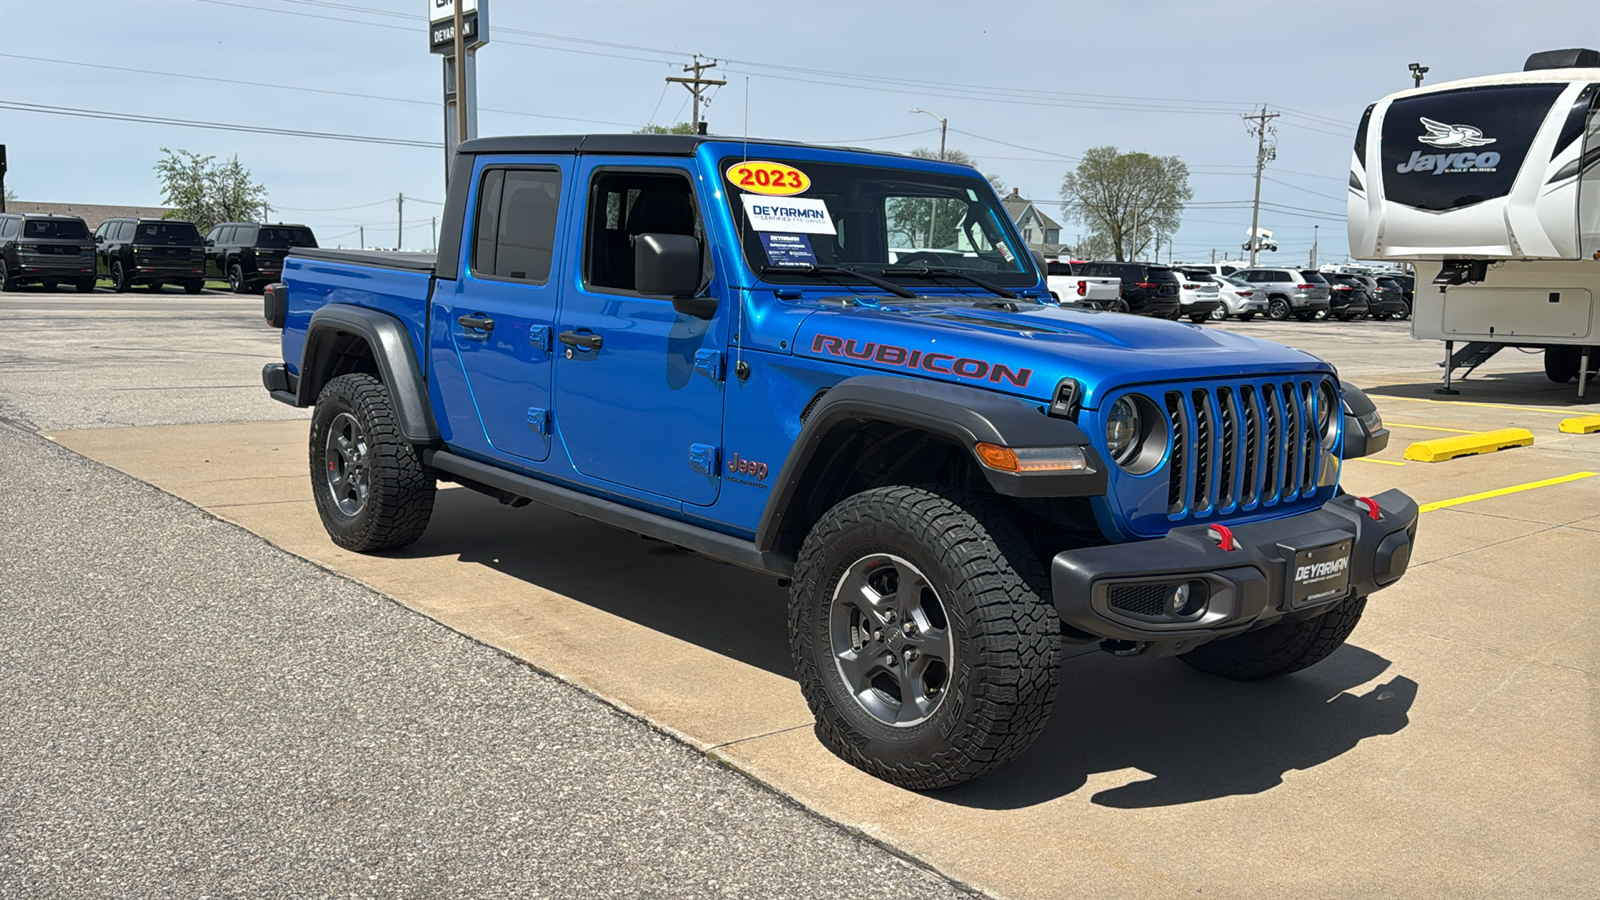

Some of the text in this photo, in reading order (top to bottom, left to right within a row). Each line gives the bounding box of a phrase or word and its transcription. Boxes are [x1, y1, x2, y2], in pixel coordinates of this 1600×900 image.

[1396, 150, 1501, 175] Jayco
[738, 168, 803, 189] 2023
[753, 205, 825, 219] DEYARMAN
[811, 334, 1033, 388] RUBICON
[727, 452, 769, 482] Jeep
[1295, 555, 1349, 581] DEYARMAN
